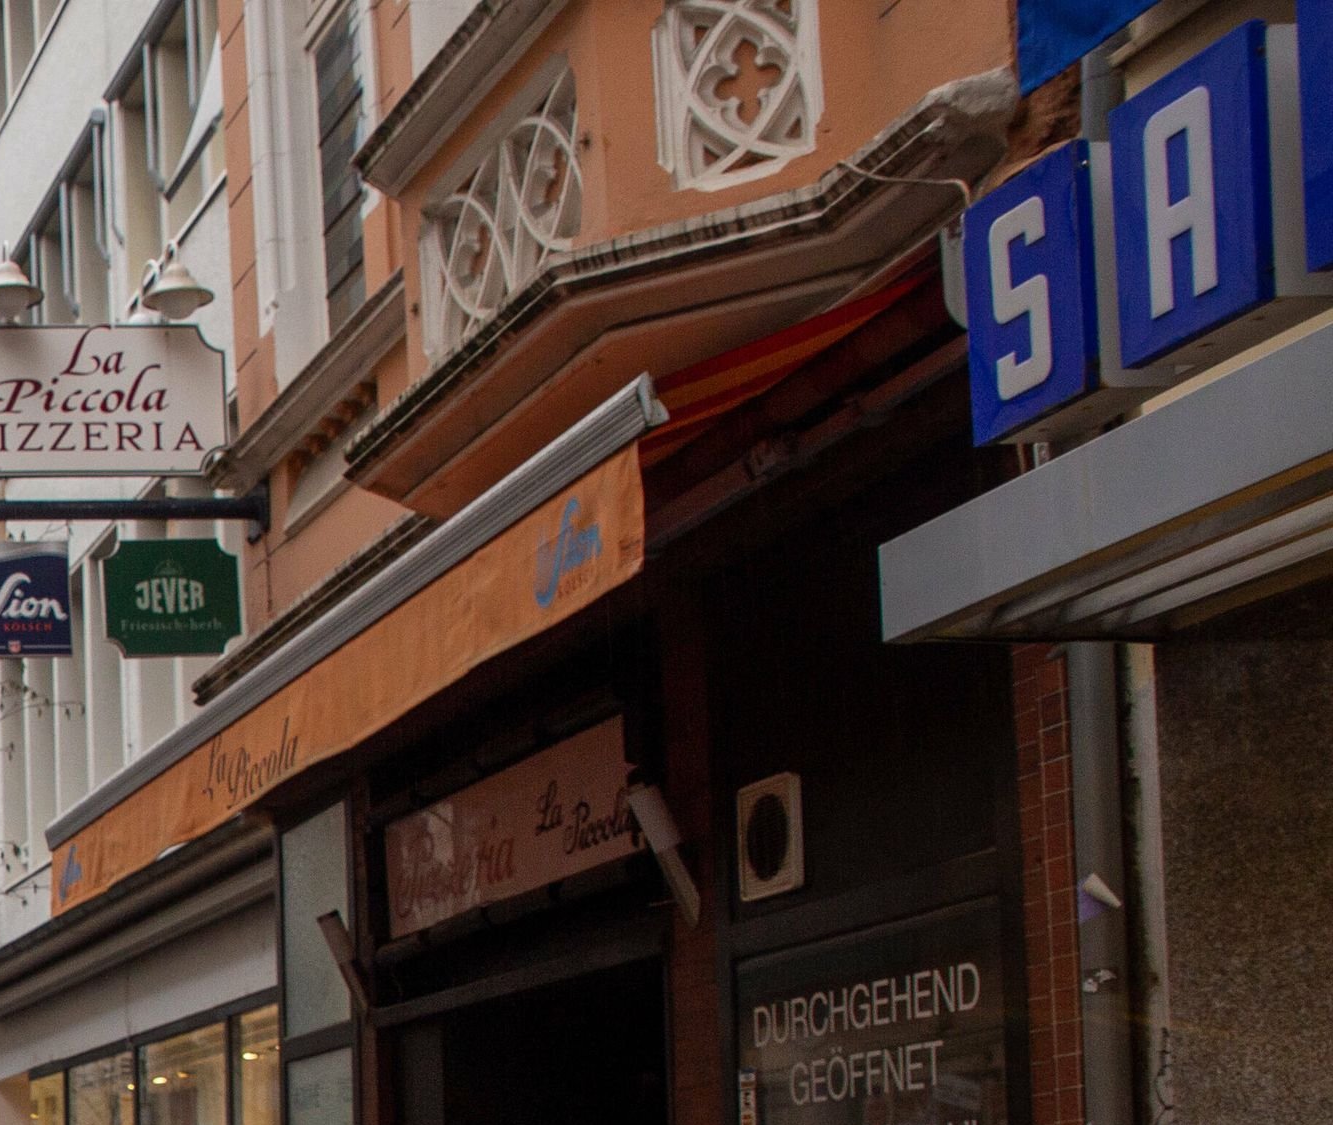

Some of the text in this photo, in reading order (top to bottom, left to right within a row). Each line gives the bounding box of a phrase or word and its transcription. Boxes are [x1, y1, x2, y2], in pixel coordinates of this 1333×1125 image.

[60, 326, 125, 377] La
[134, 576, 206, 615] JEVER
[226, 716, 300, 811] Piccola
[535, 779, 564, 837] La
[753, 962, 981, 1049] DURCHGEHEND
[789, 1040, 945, 1106] GEÖFFNET
